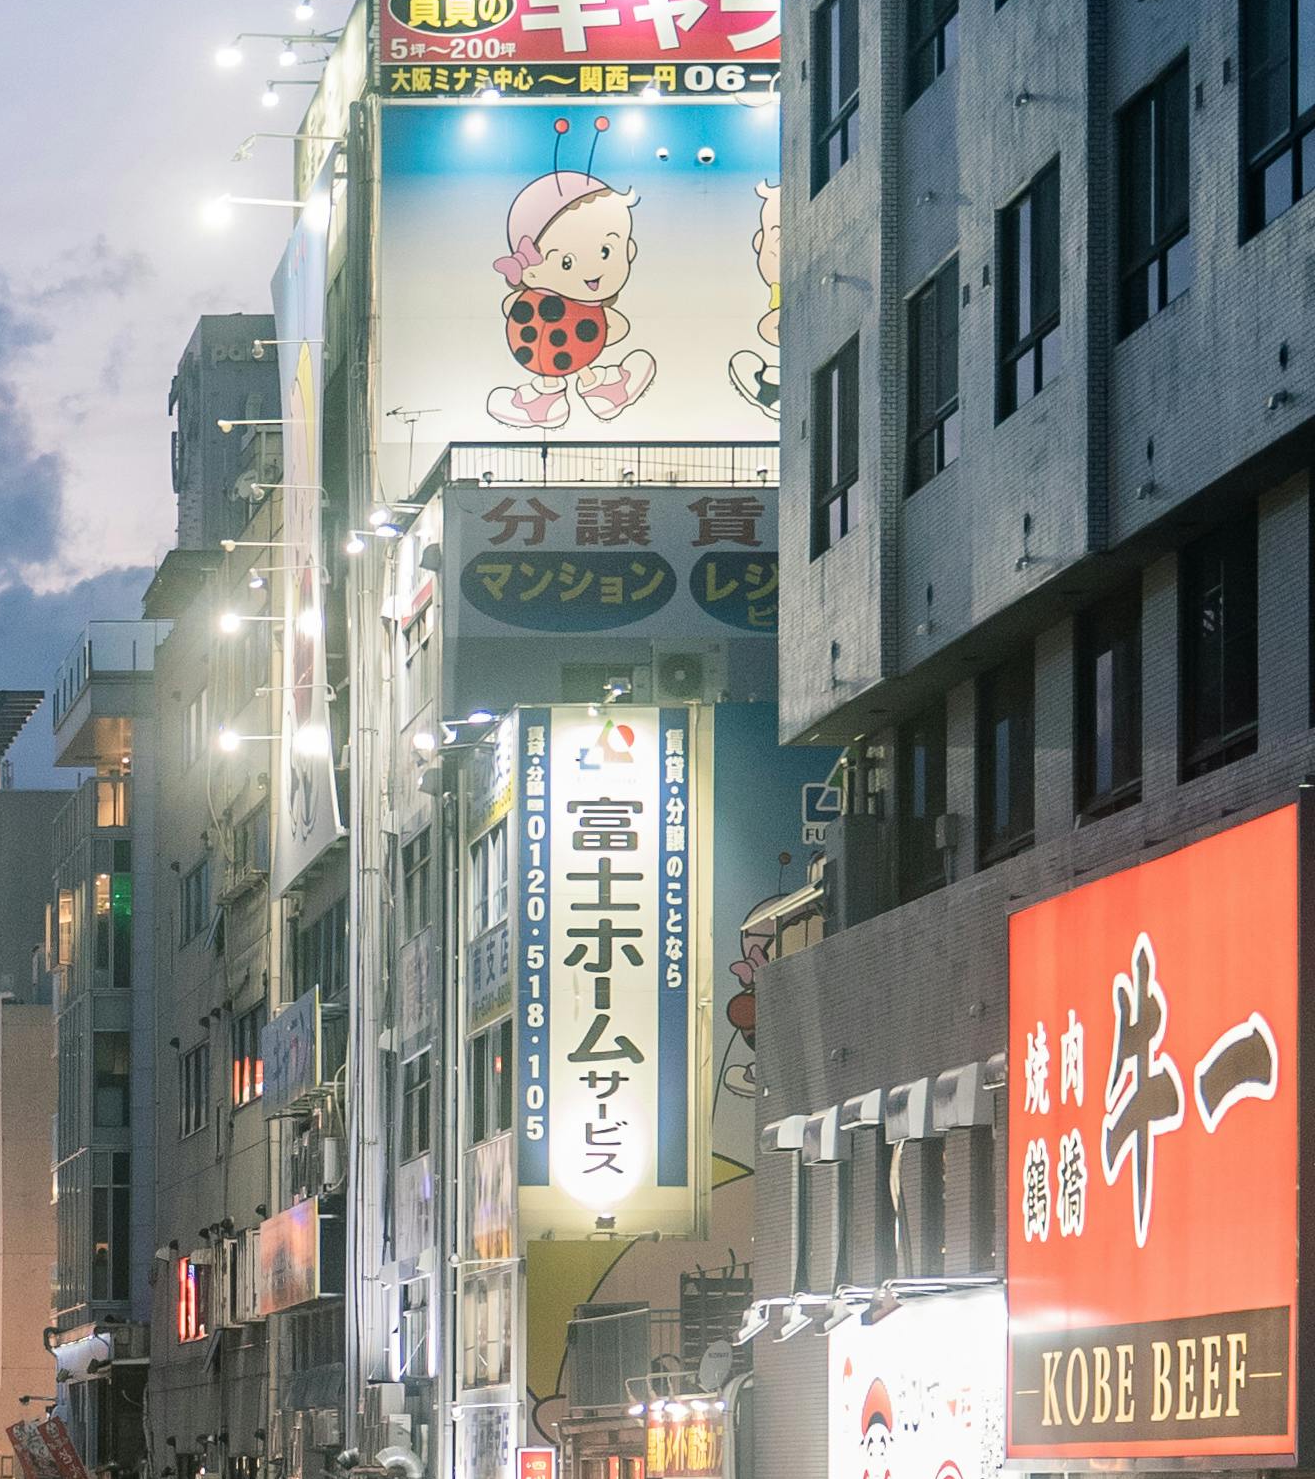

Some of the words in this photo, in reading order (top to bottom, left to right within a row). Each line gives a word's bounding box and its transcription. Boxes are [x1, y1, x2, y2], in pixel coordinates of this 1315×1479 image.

[481, 495, 653, 547] 分譲
[475, 562, 666, 604] マンション
[1022, 1009, 1084, 1115] 焼肉
[1022, 1126, 1088, 1242] 鶴橋
[1041, 1346, 1136, 1427] KOBE
[1151, 1332, 1250, 1422] BEEF
